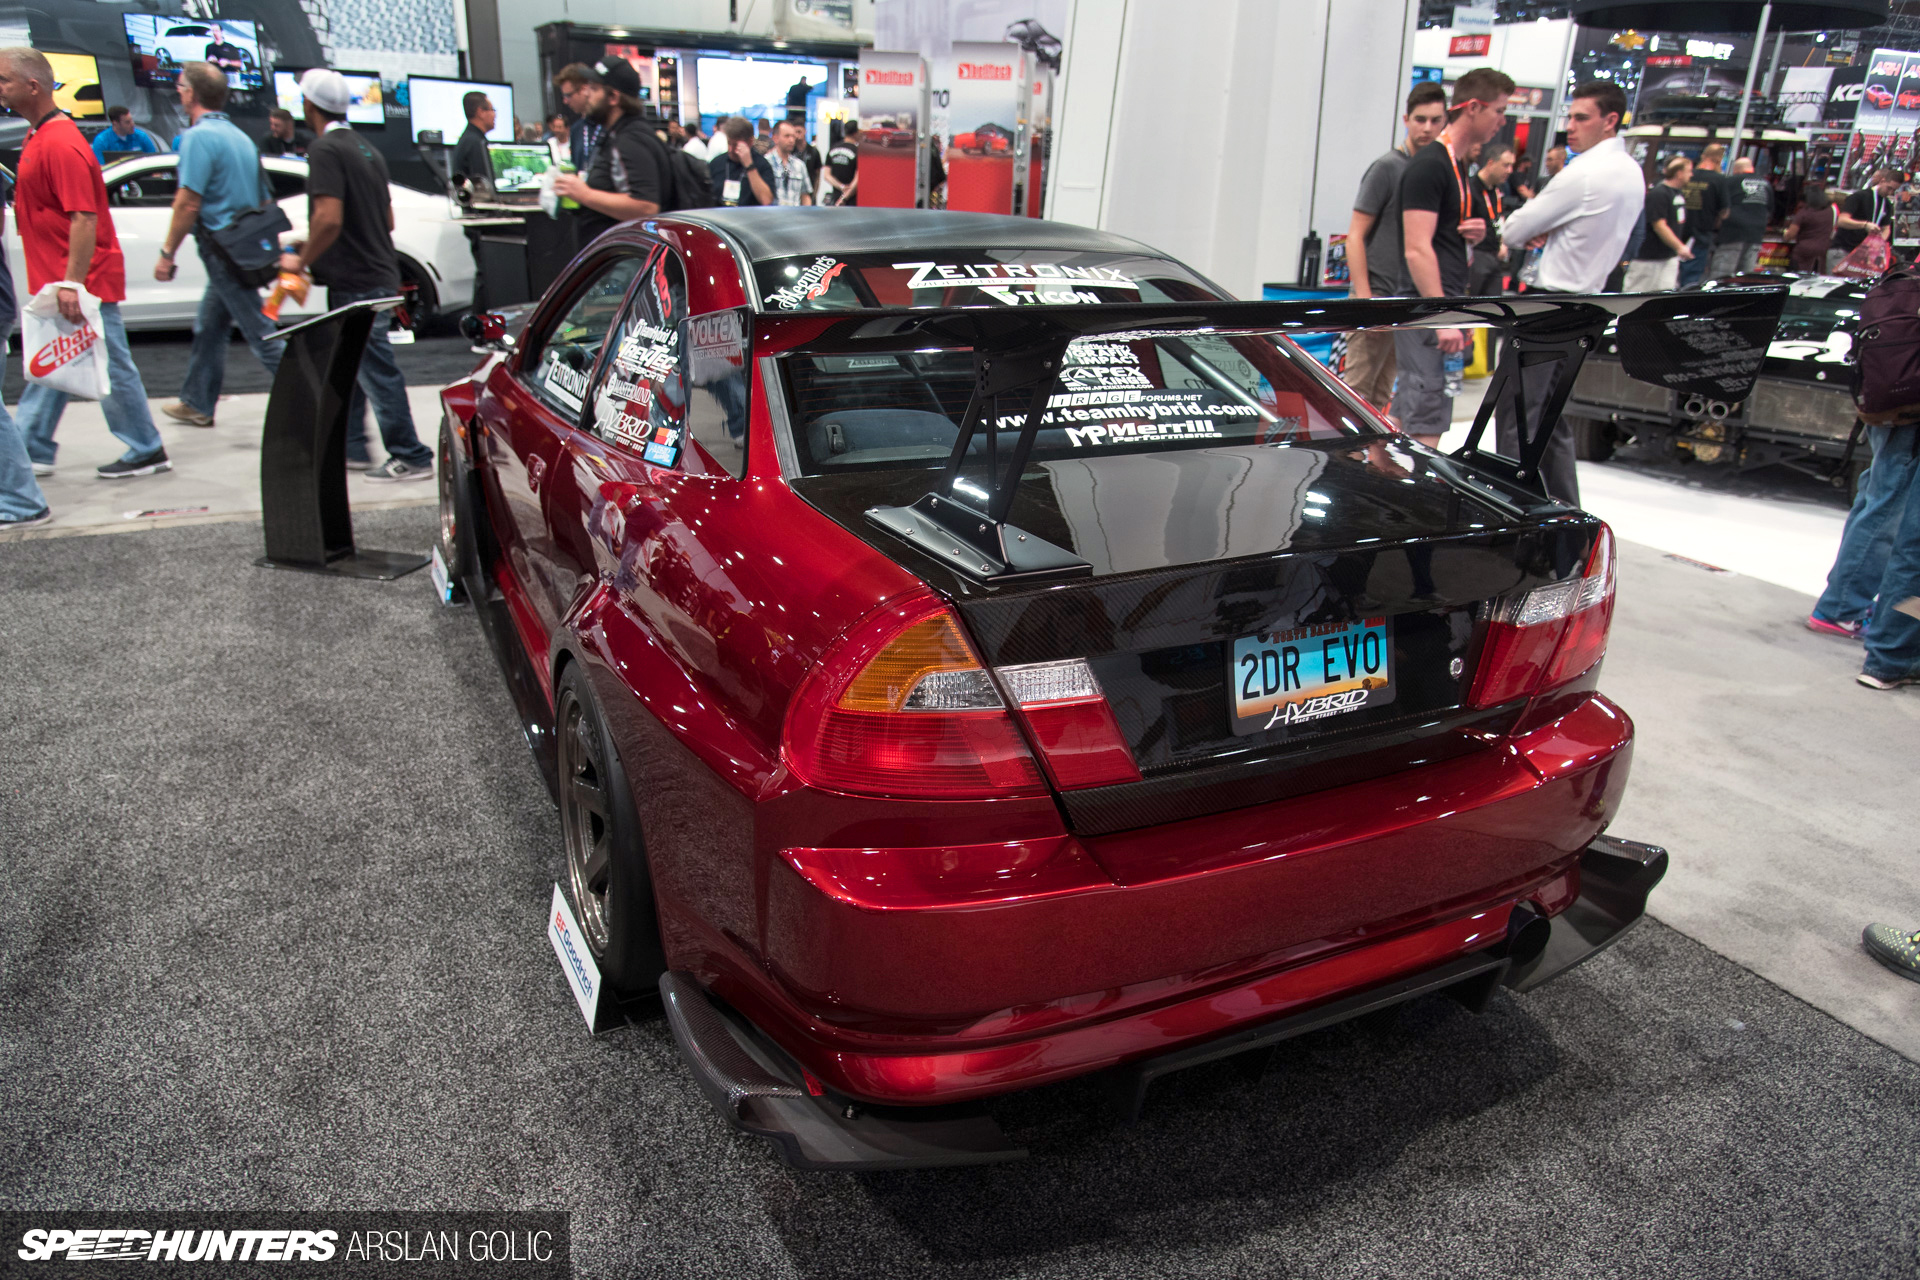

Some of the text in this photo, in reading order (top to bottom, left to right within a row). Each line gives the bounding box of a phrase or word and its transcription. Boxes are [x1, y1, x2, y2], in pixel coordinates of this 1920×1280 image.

[892, 262, 1139, 289] ZEITRONIX
[29, 322, 95, 378] Eibac
[691, 313, 739, 346] VOLTEX
[544, 350, 590, 412] ZEITRONIX
[1073, 366, 1146, 379] APEX
[1099, 376, 1151, 386] KINGS
[1241, 631, 1380, 700] 2DR EVO
[1264, 689, 1369, 730] HYBRID
[555, 911, 593, 999] BFGoodrich
